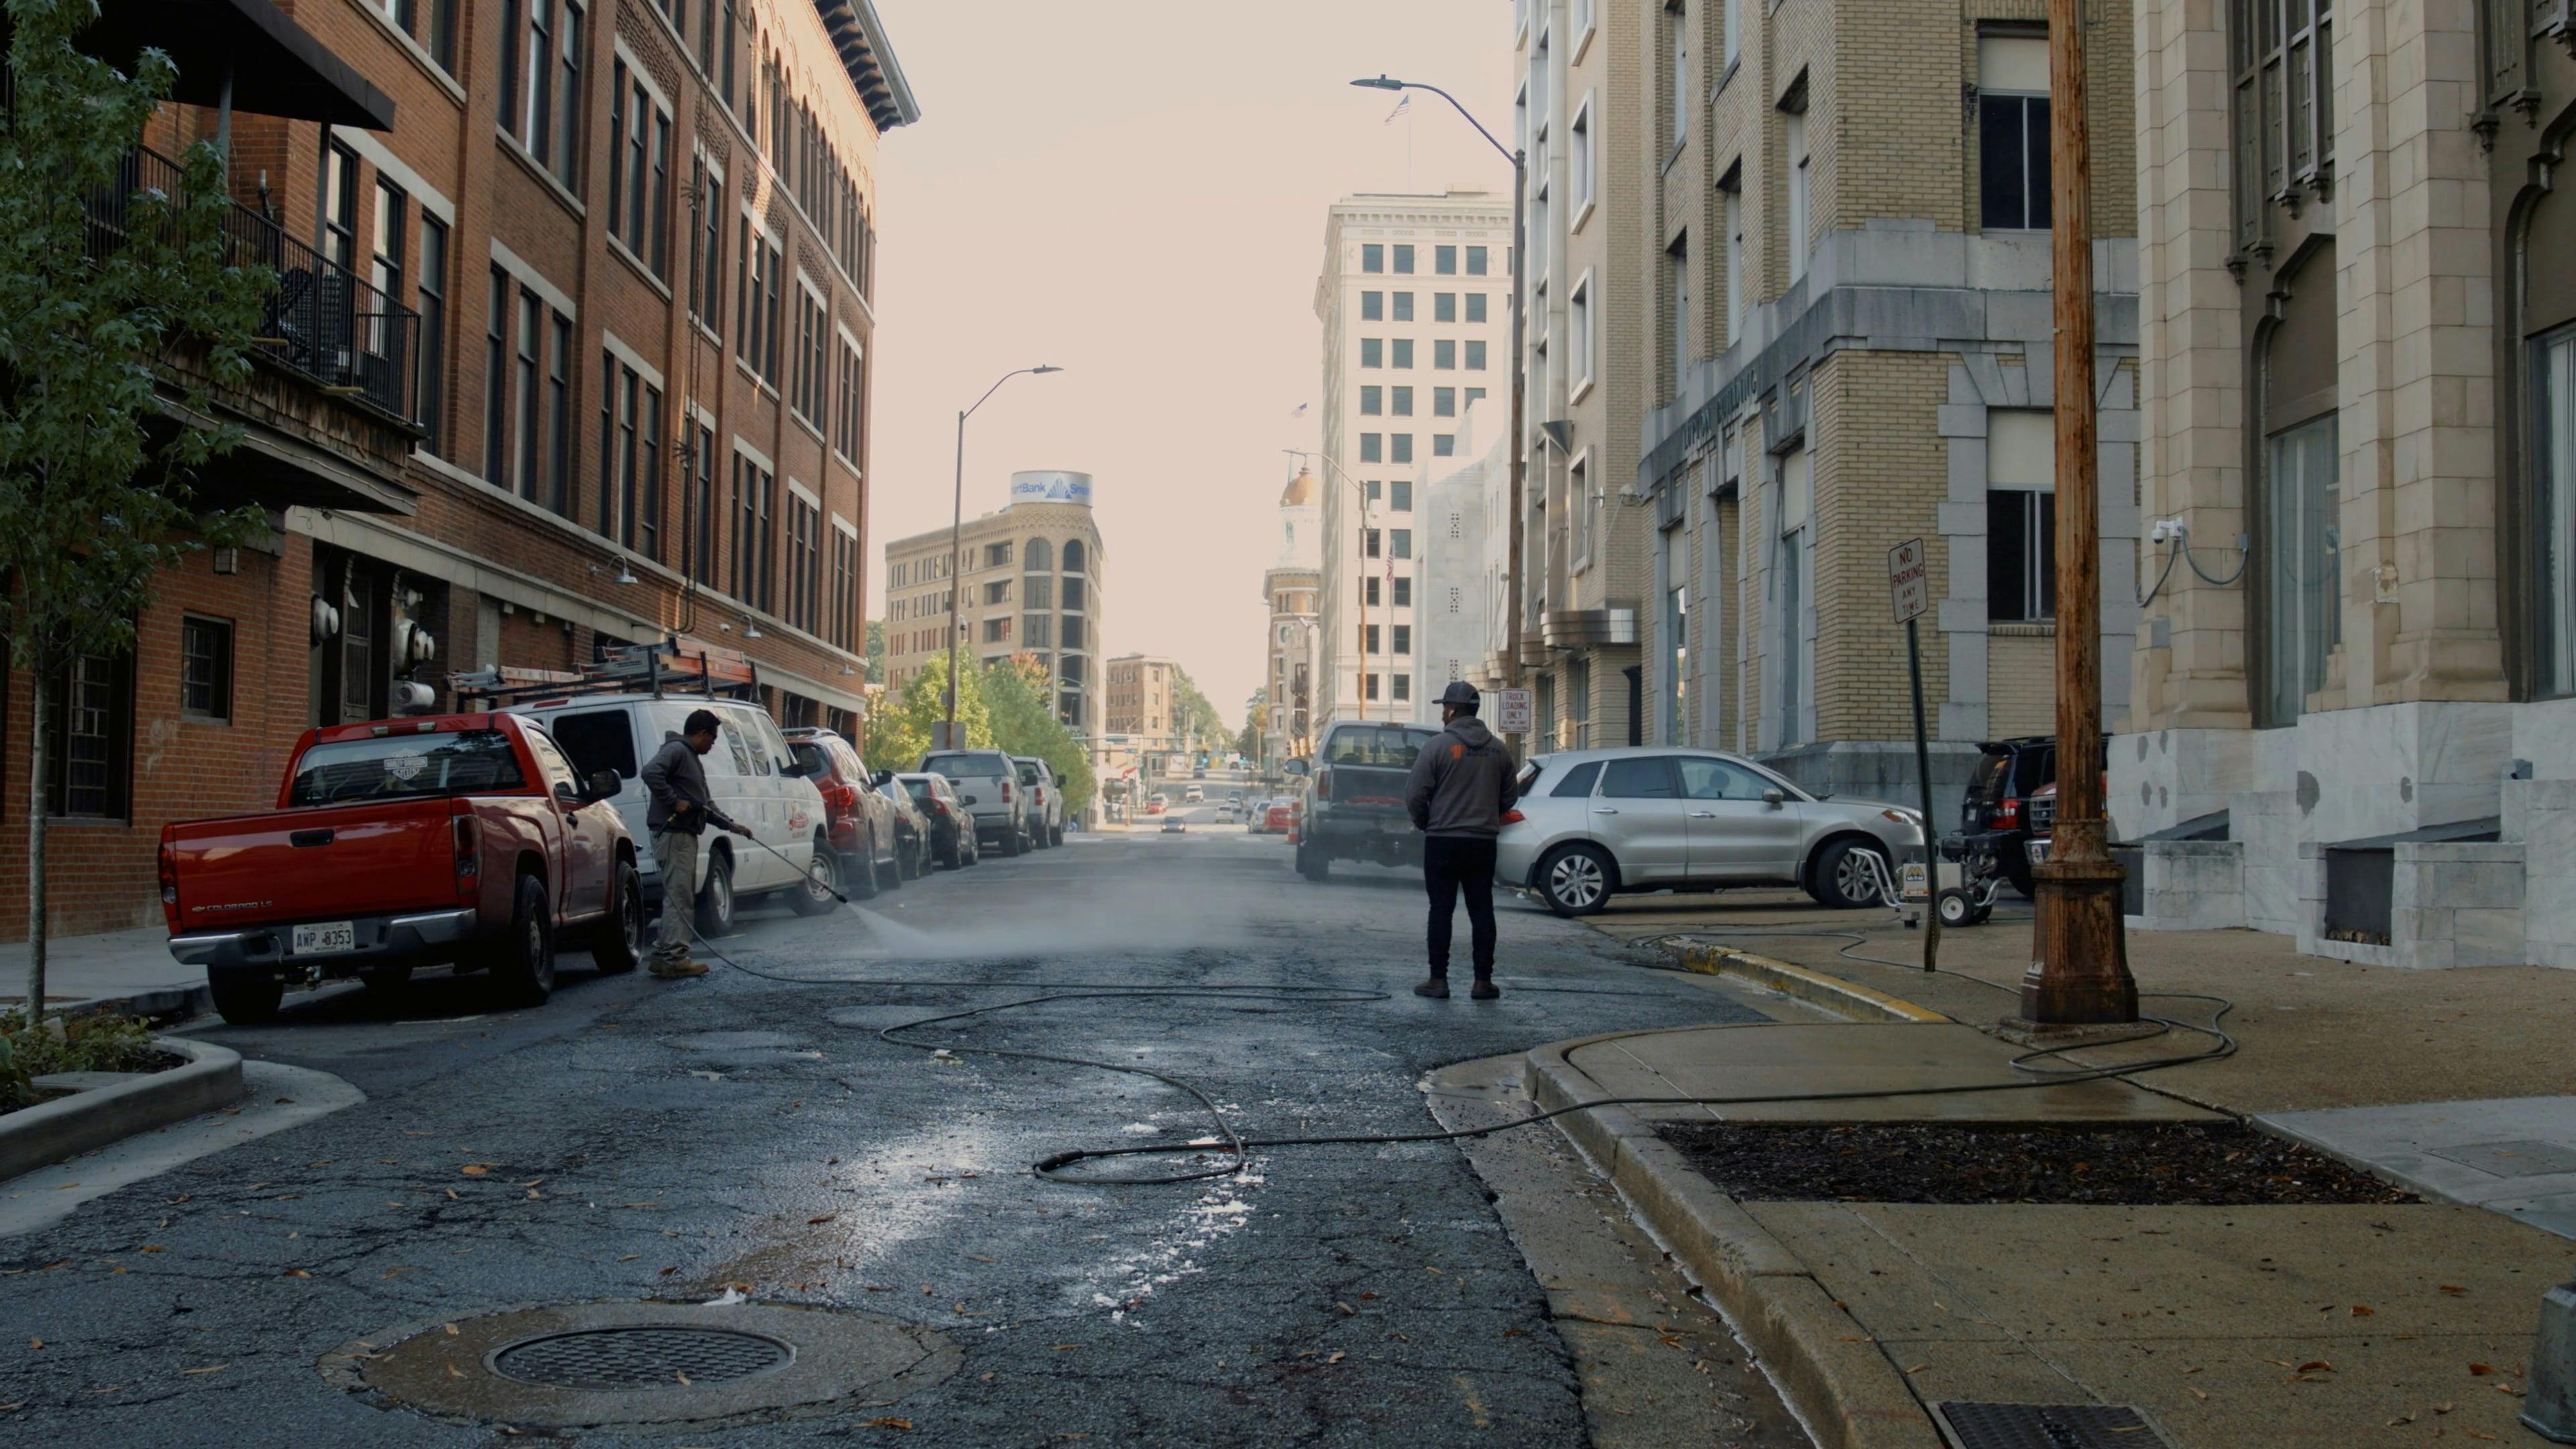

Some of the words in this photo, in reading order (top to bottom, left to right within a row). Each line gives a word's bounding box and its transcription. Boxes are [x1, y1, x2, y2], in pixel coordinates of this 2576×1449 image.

[1899, 547, 1913, 566] NO
[1892, 563, 1924, 588] PARKING
[1902, 586, 1916, 600] ANY
[1902, 599, 1919, 614] TIME
[1505, 692, 1524, 700] TRUCK
[1502, 702, 1527, 710] LOADING
[1507, 711, 1522, 719] ONLY
[207, 902, 258, 912] COLORADO
[297, 932, 316, 948] AWP
[325, 930, 351, 945] 8353
